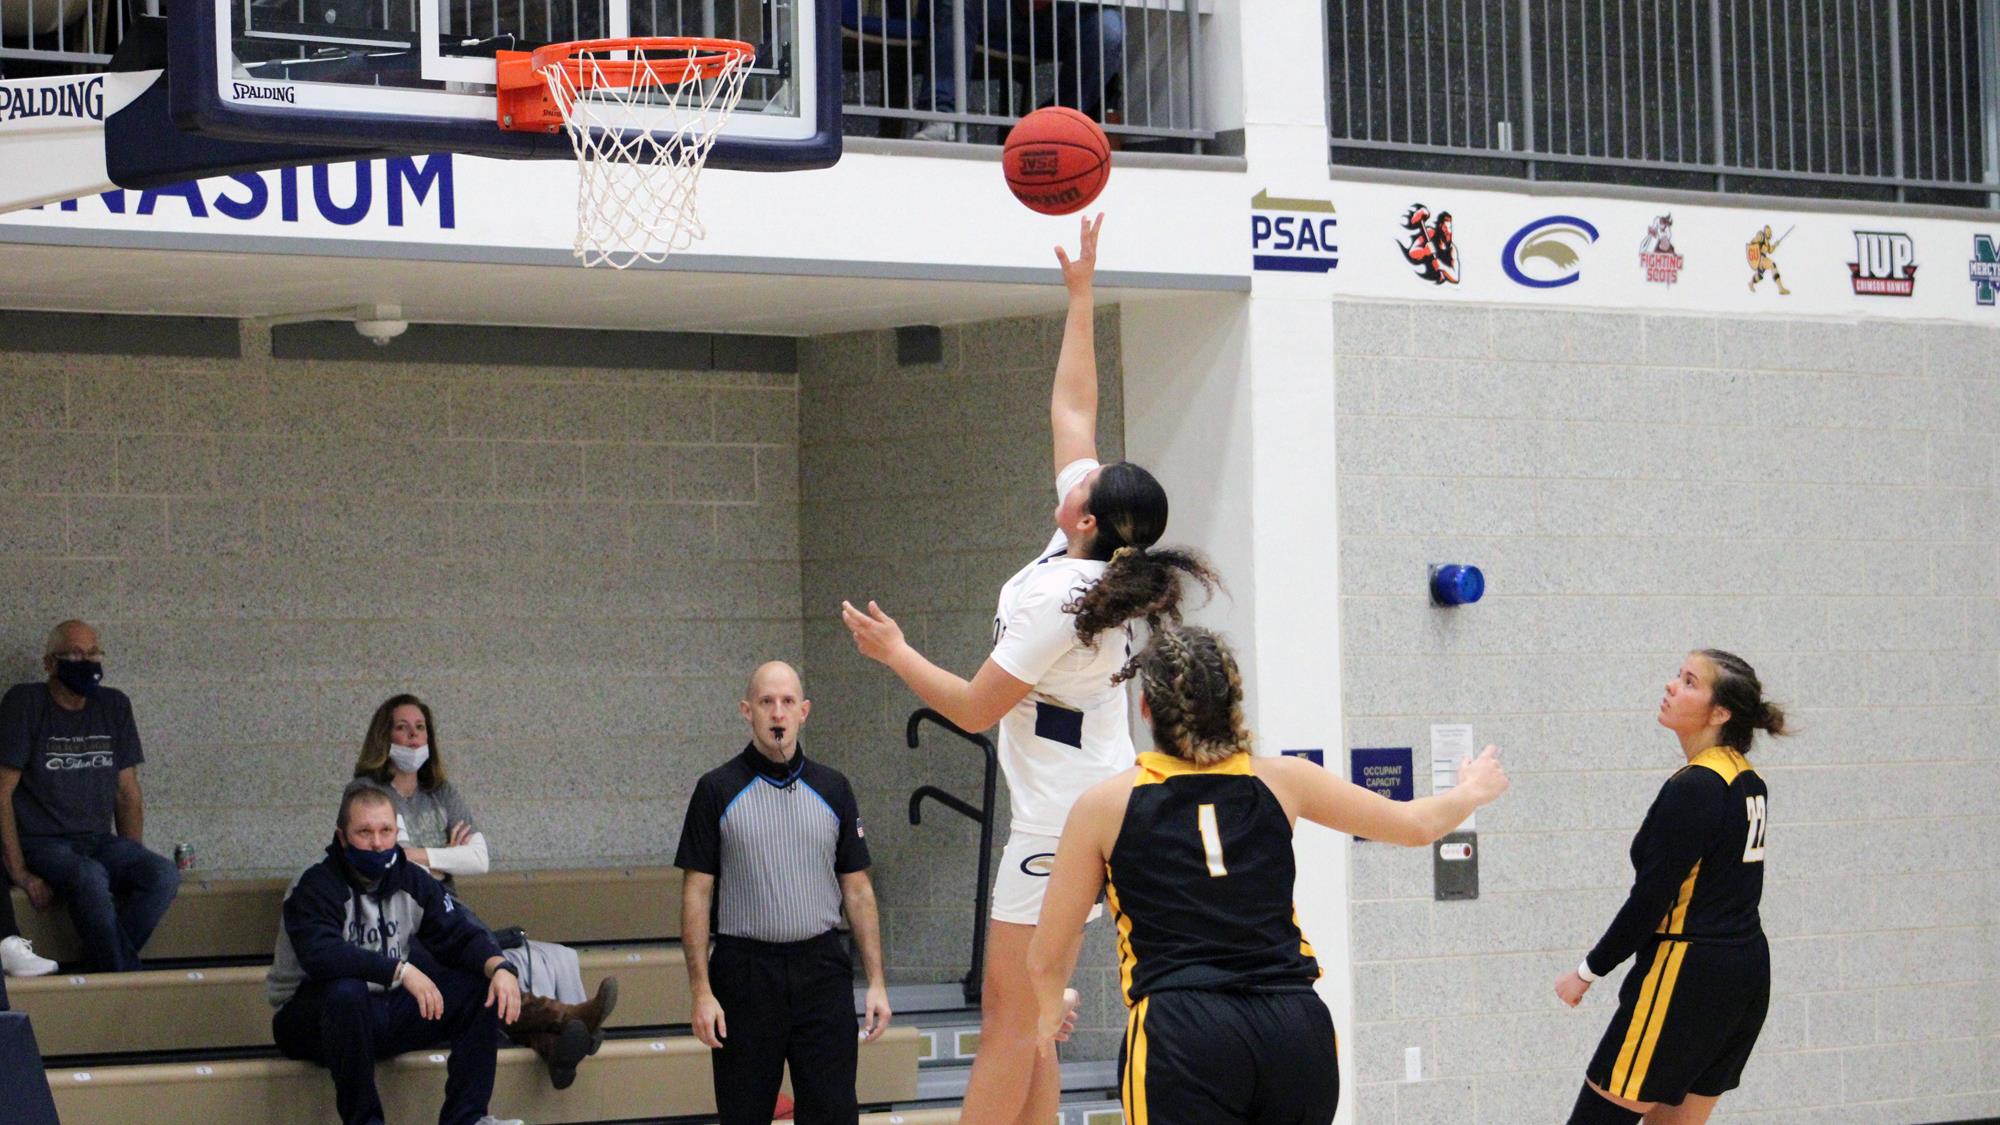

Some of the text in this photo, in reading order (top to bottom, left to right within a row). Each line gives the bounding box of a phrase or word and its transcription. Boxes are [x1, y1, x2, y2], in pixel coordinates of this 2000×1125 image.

[233, 83, 295, 104] SPALDING
[1252, 215, 1338, 252] PSAC
[1639, 253, 1684, 271] FIGHTING
[1854, 231, 1913, 279] IUP
[1646, 268, 1678, 283] SCOTS
[1856, 279, 1886, 292] CRIMSON
[1363, 766, 1402, 776] OCCUPANT
[1366, 777, 1401, 787] CAPACITY
[1742, 795, 1766, 863] 22
[1198, 804, 1228, 877] 1
